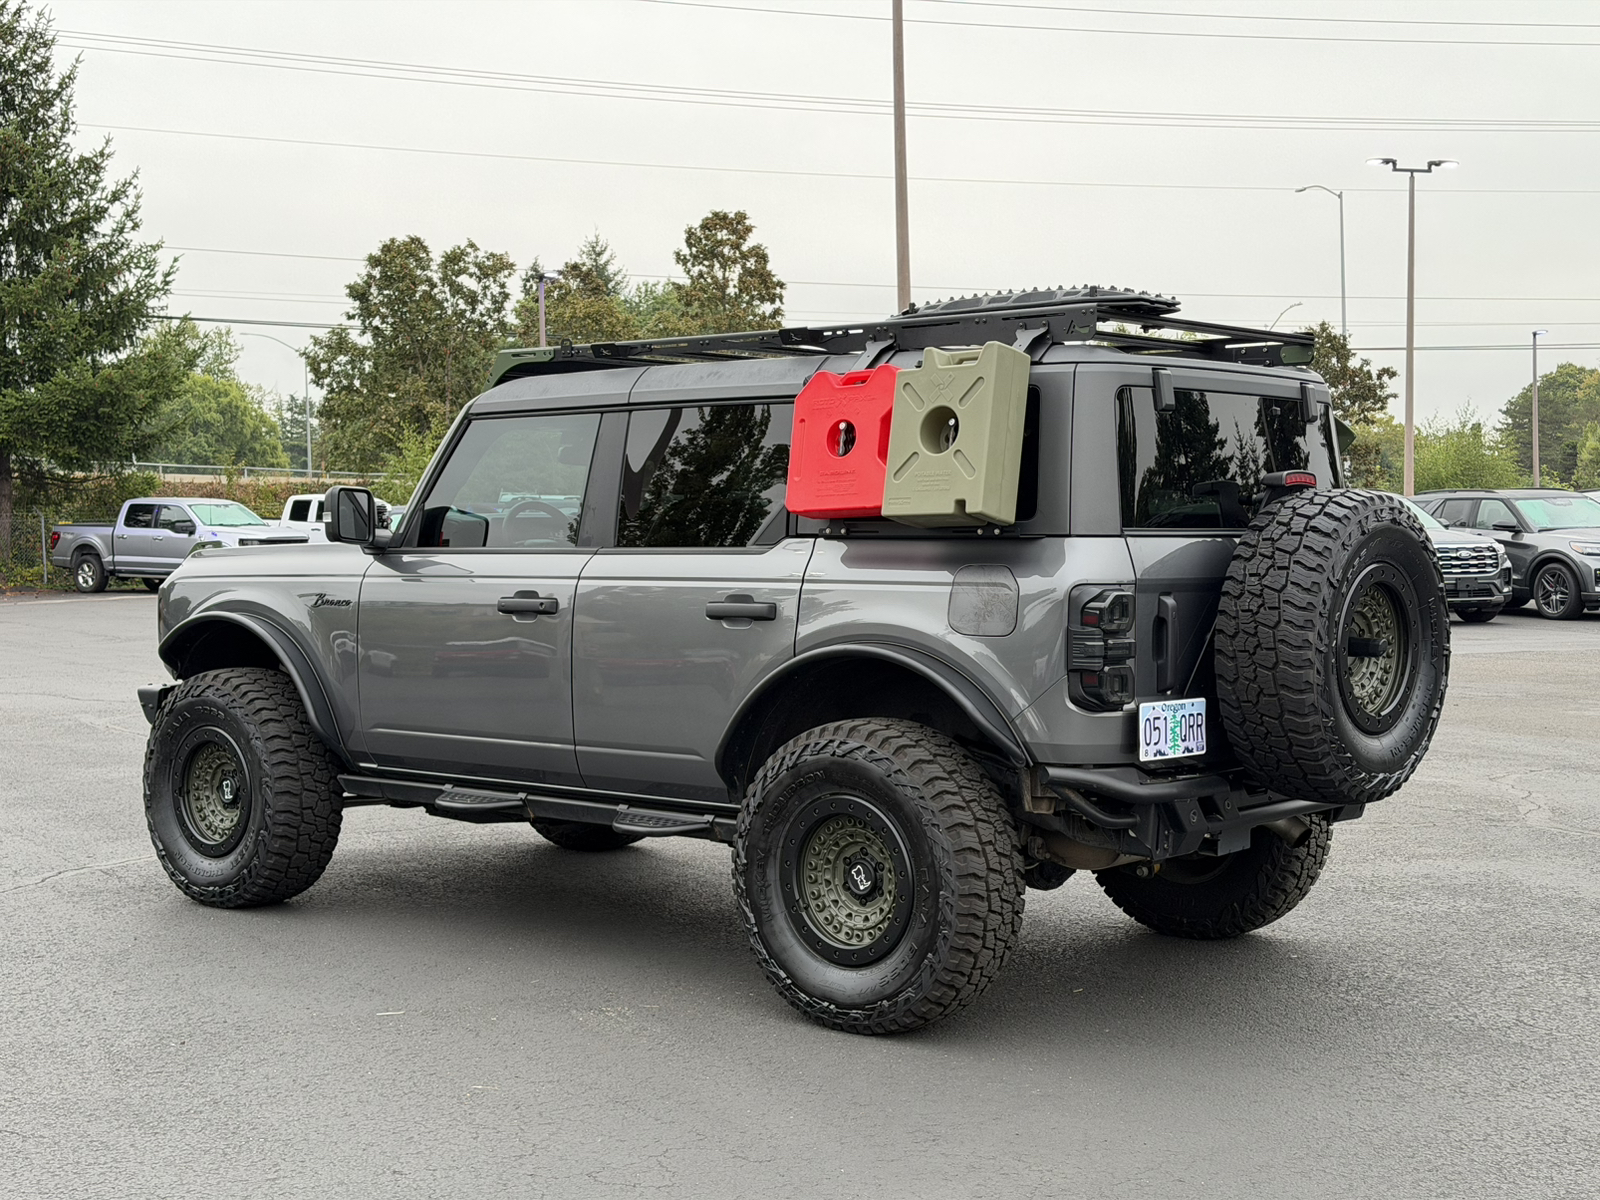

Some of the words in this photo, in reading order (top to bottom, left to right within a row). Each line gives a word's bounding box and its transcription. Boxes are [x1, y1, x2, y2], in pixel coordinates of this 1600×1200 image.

[310, 593, 353, 608] Bronco
[1161, 703, 1187, 714] Oregon
[1143, 716, 1168, 747] 051
[1180, 713, 1204, 743] QRR
